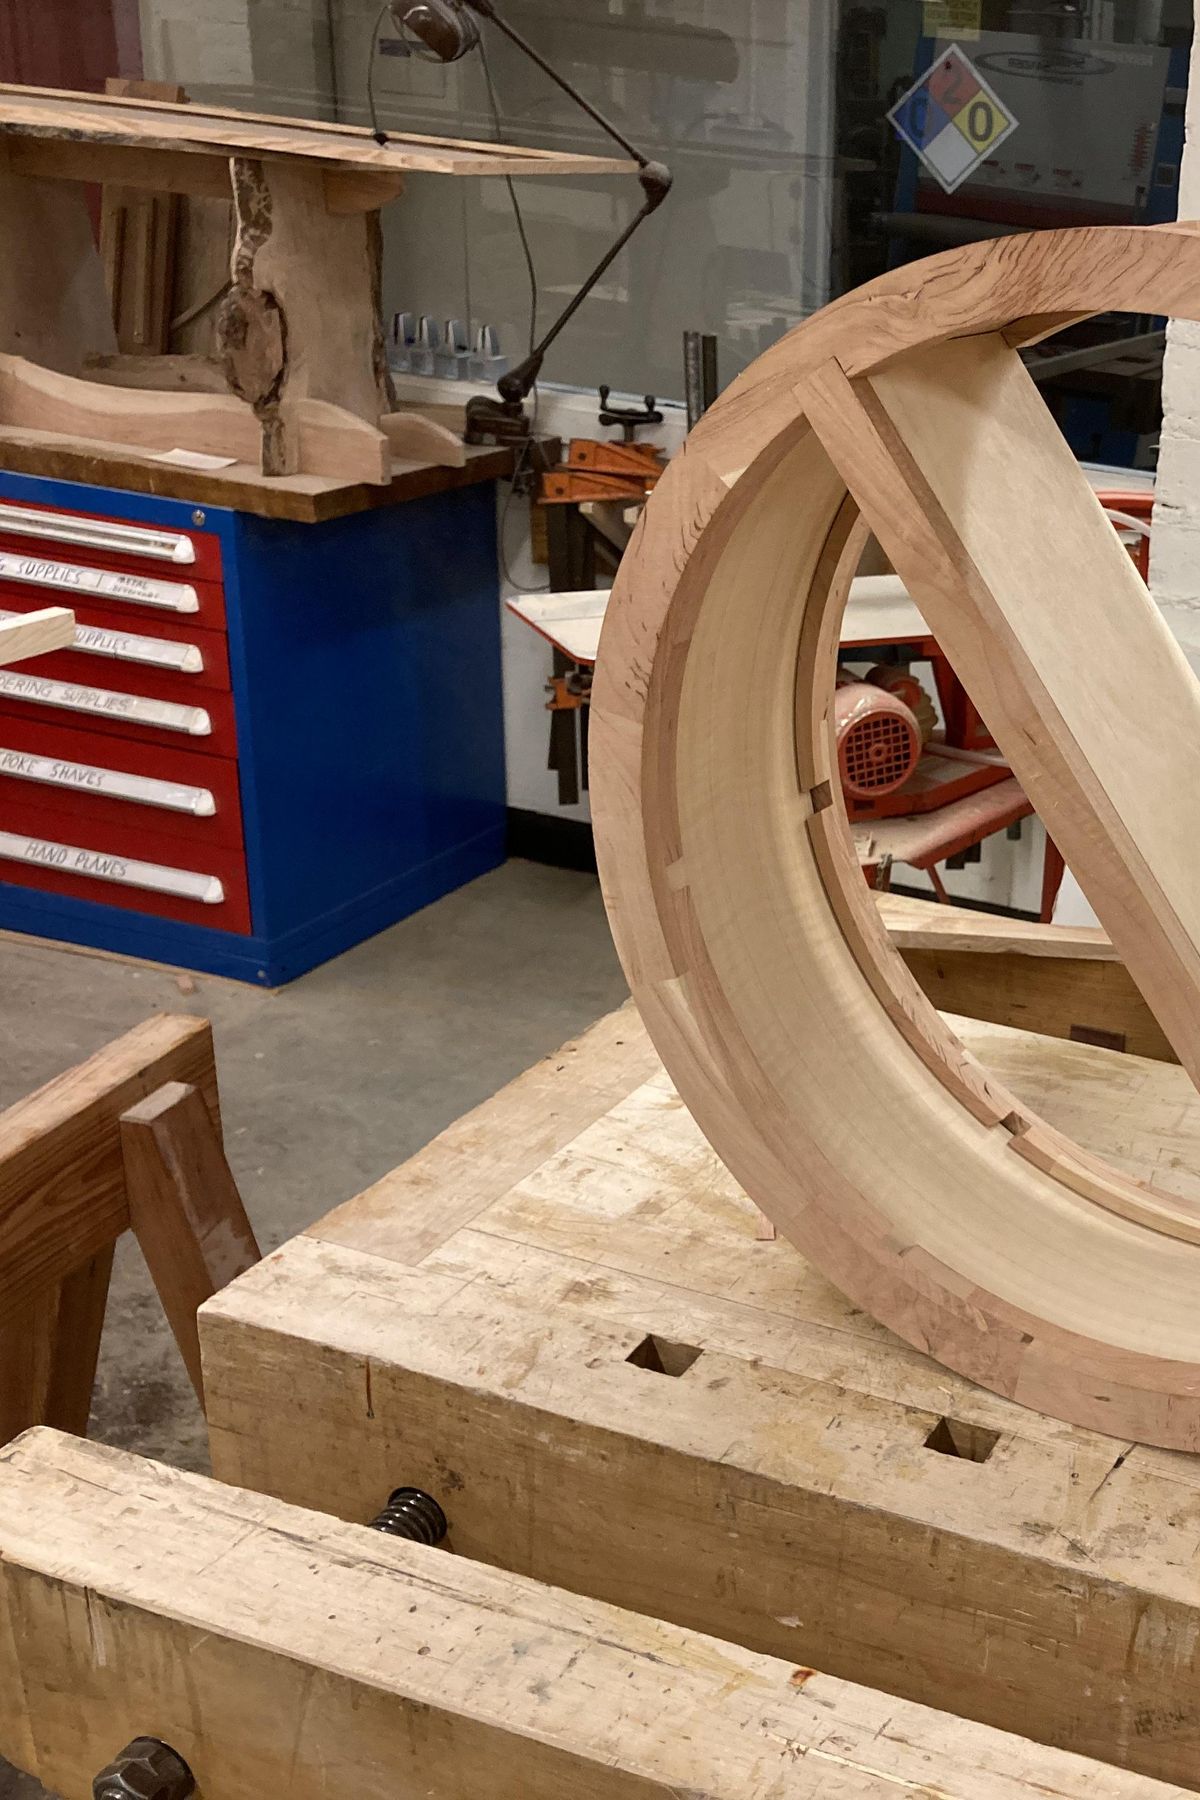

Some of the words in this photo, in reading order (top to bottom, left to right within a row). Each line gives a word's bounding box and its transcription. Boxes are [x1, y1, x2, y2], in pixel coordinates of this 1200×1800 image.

[968, 101, 993, 142] 0
[16, 558, 86, 585] SUPPLIES
[75, 630, 130, 650] UPPLIES
[63, 687, 132, 711] SUPPLIES
[0, 751, 38, 772] POKE
[50, 762, 106, 787] SHAVES
[24, 841, 68, 864] HAND
[74, 852, 129, 877] PLANES
